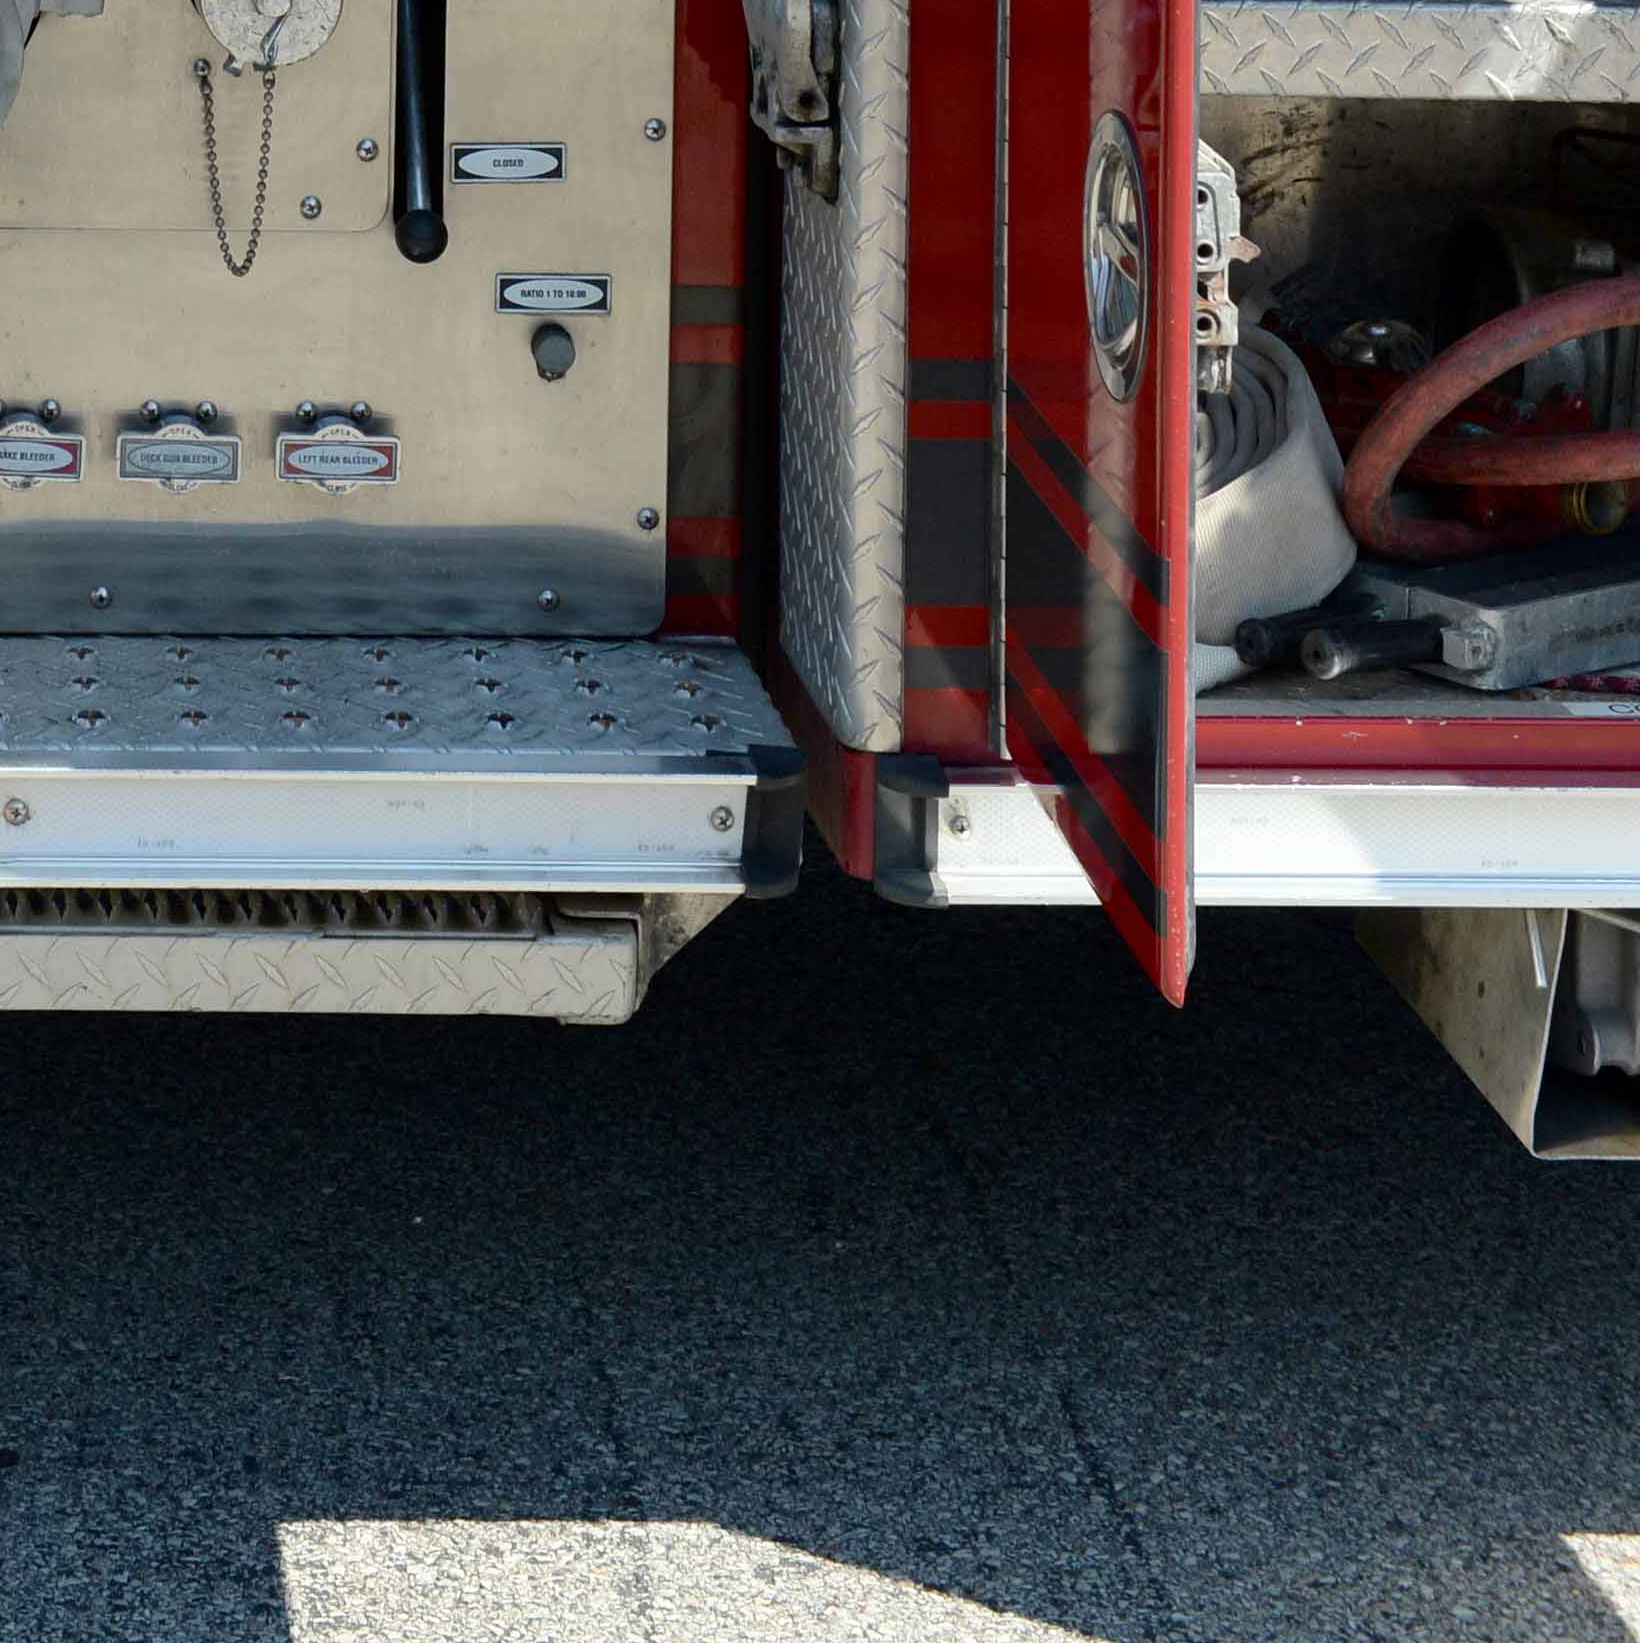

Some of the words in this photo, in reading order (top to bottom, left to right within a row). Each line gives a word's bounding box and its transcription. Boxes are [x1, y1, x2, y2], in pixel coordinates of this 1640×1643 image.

[492, 159, 524, 167] CLOSED
[521, 290, 544, 298] RATIO
[20, 451, 55, 461] BLEEDER
[141, 454, 161, 462] DECK
[182, 455, 217, 464] BLEEDER
[298, 455, 317, 464] LEFT
[319, 453, 340, 464] REAR
[342, 456, 378, 464] BLEEDER
